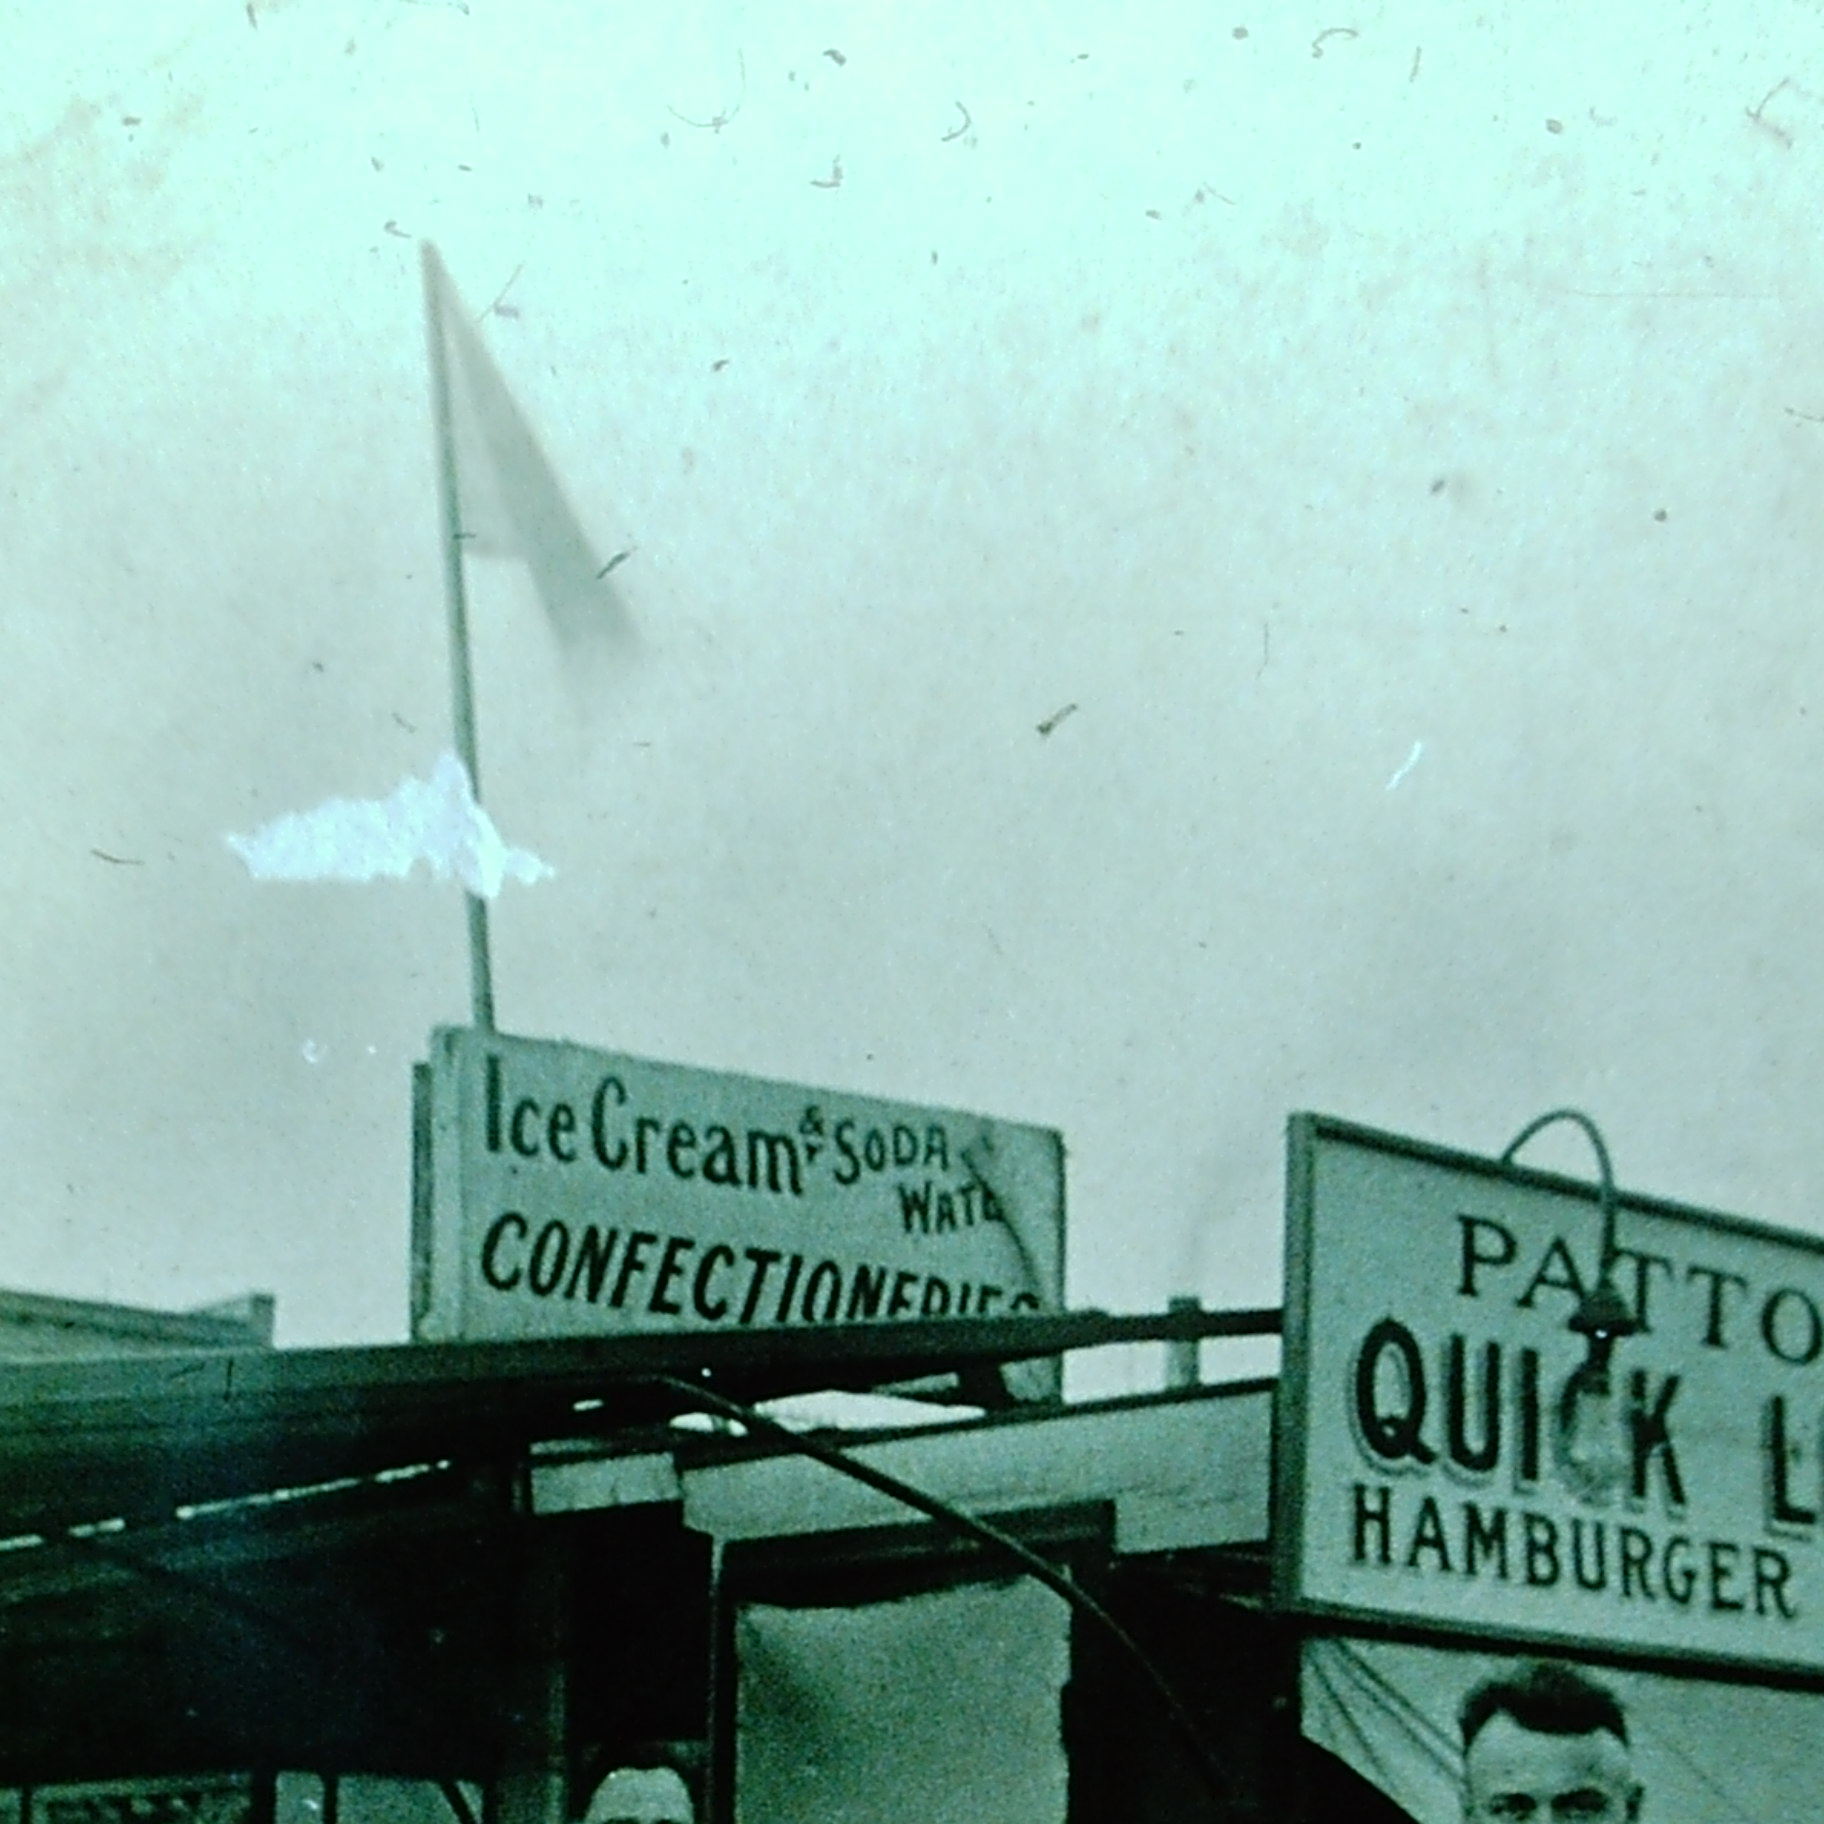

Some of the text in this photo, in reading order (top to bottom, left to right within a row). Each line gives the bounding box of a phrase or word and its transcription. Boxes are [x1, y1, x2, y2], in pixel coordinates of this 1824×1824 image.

[484, 1054, 577, 1163] Ice
[590, 1076, 803, 1197] Cream
[482, 1211, 1040, 1326] CONFECTIONER
[1350, 1316, 1689, 1514] QUICK
[1351, 1483, 1800, 1621] HAMBURGER
